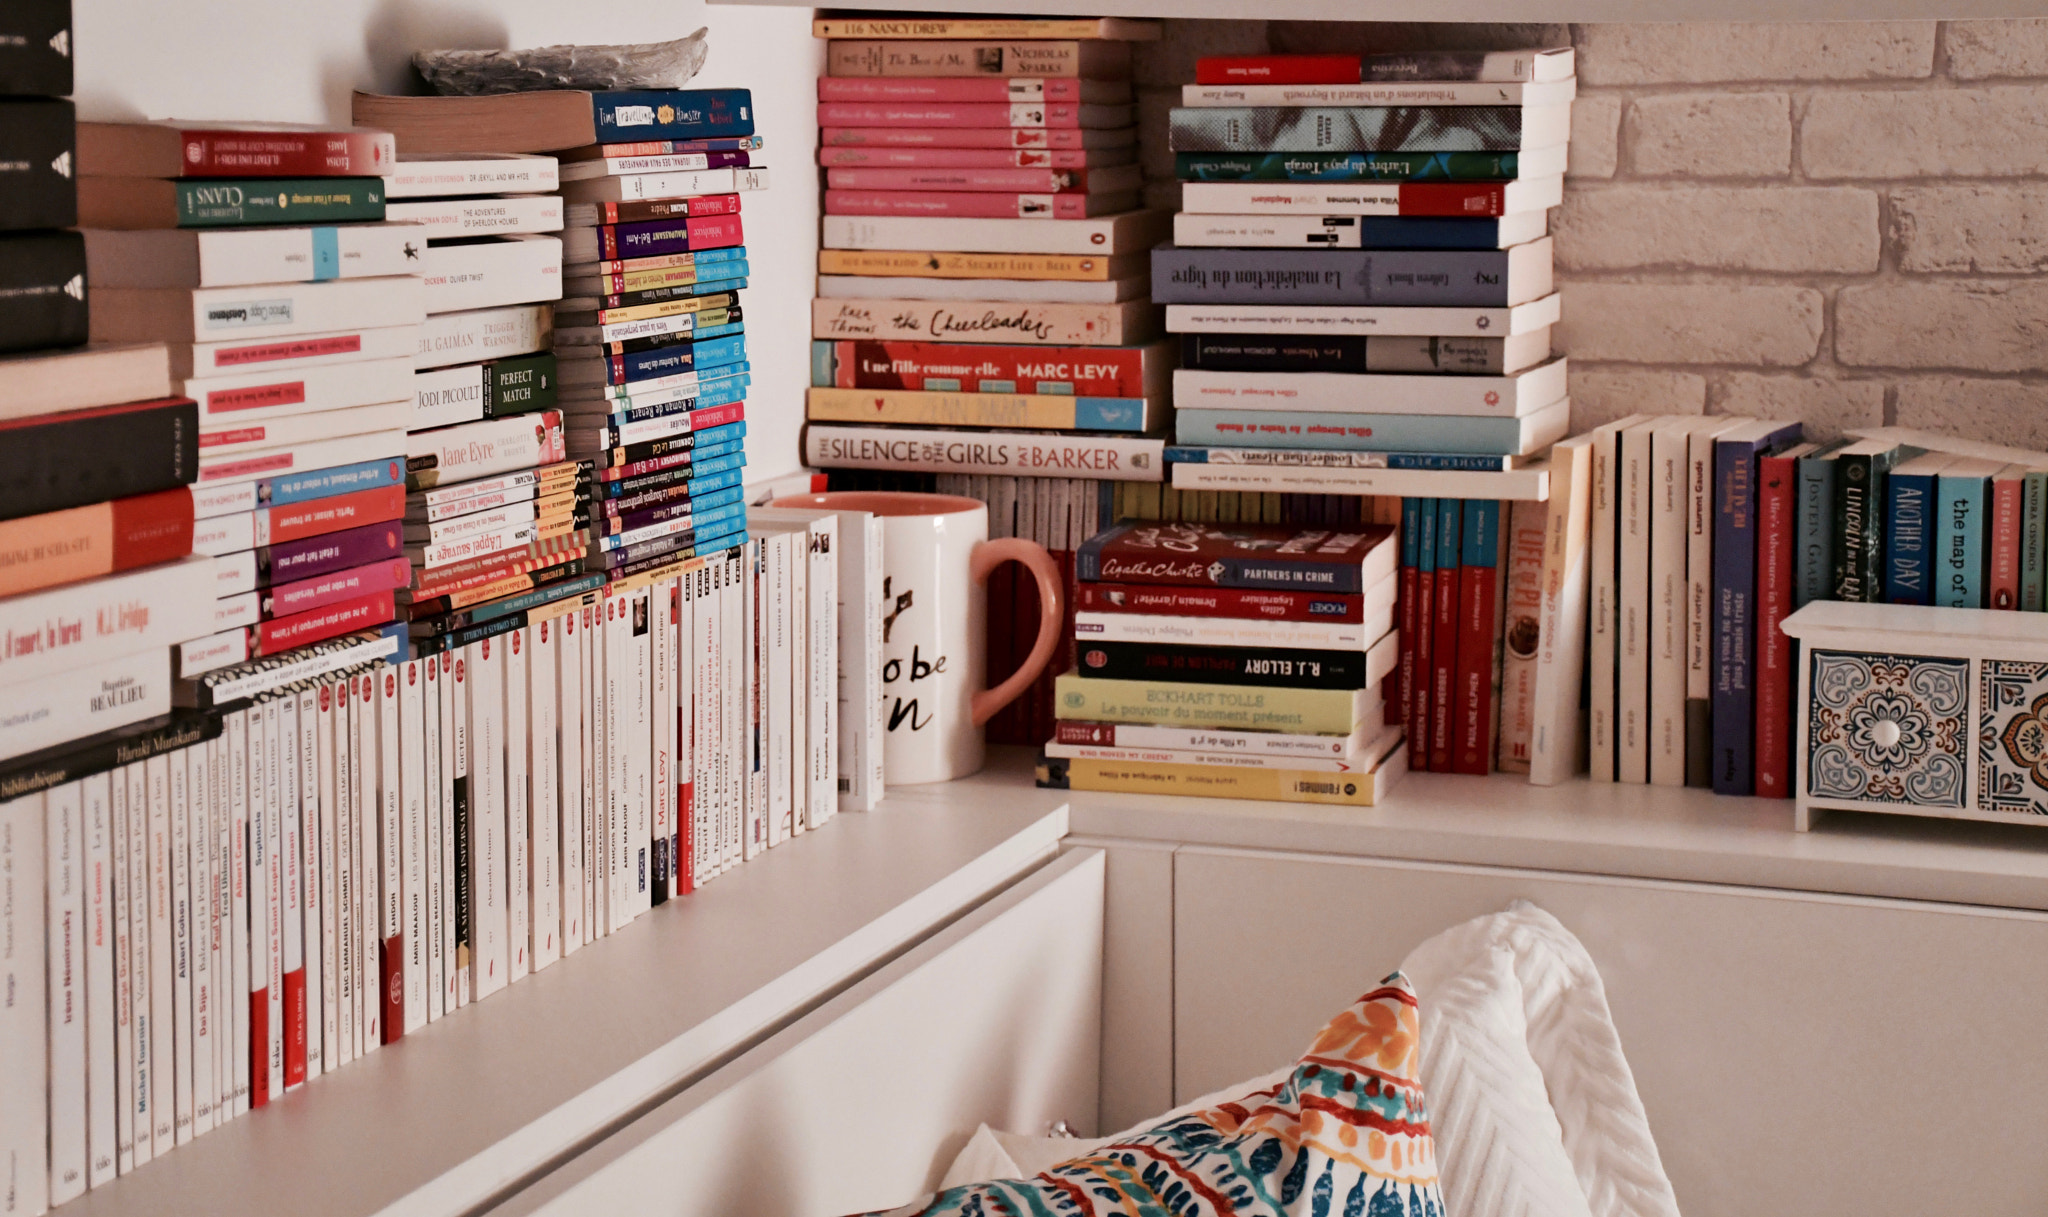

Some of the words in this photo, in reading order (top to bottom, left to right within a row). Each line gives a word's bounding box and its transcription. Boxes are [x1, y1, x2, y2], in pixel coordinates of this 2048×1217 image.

[869, 22, 909, 35] NANCY
[912, 22, 949, 35] DREW
[1010, 46, 1070, 59] NICHOLAS
[1017, 62, 1062, 73] SPARKS
[1283, 88, 1329, 102] Beyrouth
[1339, 89, 1371, 102] bâtard
[1373, 89, 1393, 102] d'un
[1395, 89, 1457, 102] Tribulations
[599, 107, 616, 126] Time
[617, 108, 653, 126] Travelling
[676, 106, 702, 123] Hamster
[326, 139, 349, 155] JAMES
[326, 156, 350, 171] ELOISA
[672, 157, 690, 169] JOURNAL
[1284, 159, 1323, 175] Toraja
[1323, 158, 1349, 173] pays
[1351, 161, 1368, 174] du
[1368, 161, 1411, 175] L'arbre
[516, 171, 530, 181] HYDE
[196, 186, 244, 207] CLANS
[463, 208, 473, 217] THE
[474, 207, 506, 217] ADVENTURES
[463, 219, 472, 228] OF
[472, 217, 498, 228] SHERLOCK
[499, 216, 519, 227] HOLMES
[626, 232, 651, 246] Bel-Ami
[652, 229, 688, 241] MAUPASSANT
[967, 259, 1006, 271] SECRET
[1009, 260, 1034, 271] LIFE
[424, 276, 447, 286] DICKENS
[449, 274, 468, 285] OLIVER
[468, 273, 484, 283] TWIST
[1170, 264, 1209, 290] tigre
[1212, 270, 1231, 290] du
[1234, 270, 1320, 291] malédiction
[1323, 270, 1342, 290] La
[207, 308, 247, 322] Constance
[484, 322, 515, 334] TRIGGER
[892, 312, 920, 331] the
[930, 309, 1055, 340] Cheerleaders
[435, 332, 474, 352] GAIMAN
[482, 334, 517, 349] WARNING
[892, 358, 920, 375] fille
[923, 361, 973, 375] comme
[974, 360, 1001, 376] elle
[1016, 361, 1068, 379] MARC
[1073, 363, 1119, 381] LEVY
[500, 369, 533, 386] PERFECT
[417, 390, 440, 410] JODI
[442, 384, 480, 405] PICOULT
[502, 387, 532, 403] MATCH
[687, 397, 696, 409] Le
[631, 405, 655, 420] Renart
[655, 404, 664, 416] de
[664, 399, 687, 413] Roman
[668, 436, 694, 451] CORNEILLE
[831, 438, 919, 462] SILENCE
[947, 443, 1009, 466] GIRLS
[440, 445, 468, 469] Jane
[468, 441, 495, 462] Eyre
[1017, 445, 1029, 467] PAT
[1032, 448, 1119, 471] BARKER
[1279, 450, 1309, 464] than
[1311, 450, 1353, 464] Louder
[632, 460, 647, 476] Bal
[650, 458, 660, 472] Le
[359, 469, 379, 483] Arthur
[513, 474, 533, 487] VOLTAIRE
[1693, 460, 1704, 493] Gaudé
[1805, 475, 1823, 537] JOSTEIN
[2029, 478, 2039, 522] SANDRA
[279, 514, 304, 529] trouver
[1694, 496, 1703, 535] Laurent
[1768, 496, 1781, 529] Alice's
[1845, 487, 1863, 549] LINCOLN
[1894, 486, 1924, 553] ANOTHER
[1952, 498, 1969, 530] the
[2000, 489, 2013, 543] VERONICA
[470, 532, 503, 553] L'Appel
[514, 528, 530, 541] LONDON
[318, 548, 333, 562] était
[436, 542, 471, 562] sauvage
[1516, 528, 1544, 568] LIFE
[1949, 535, 1967, 570] map
[2027, 523, 2038, 572] CISNEROS
[290, 551, 306, 565] pour
[306, 551, 318, 563] fait
[1766, 531, 1780, 589] Adventures
[1998, 548, 2011, 580] HENRY
[1102, 558, 1152, 578] Agatha
[1150, 560, 1204, 578] Christie
[1243, 568, 1291, 582] PARTNERS
[1293, 569, 1303, 582] IN
[1305, 570, 1334, 584] CRIME
[1893, 557, 1922, 591] DAY
[316, 582, 331, 597] pour
[331, 580, 345, 593] robe
[346, 577, 359, 590] Une
[1952, 573, 1969, 600] of
[283, 586, 315, 604] Versailles
[1179, 596, 1217, 608] Demain
[1240, 595, 1294, 606] Legardinier
[1514, 589, 1541, 607] PI
[1718, 588, 1731, 617] serez
[338, 610, 351, 622] sais
[359, 605, 368, 617] Je
[1260, 605, 1286, 615] Gilles
[1308, 601, 1347, 615] POCKET
[1733, 592, 1745, 624] triste
[298, 614, 325, 632] pourquoi
[325, 610, 339, 625] plus
[270, 627, 291, 641] t'aime
[1765, 605, 1778, 669] Wonderland
[1718, 636, 1731, 661] vous
[1733, 626, 1746, 664] jamais
[1245, 658, 1292, 675] ELLORY
[1692, 645, 1702, 670] Pour
[100, 675, 135, 693] Baptiste
[1437, 667, 1448, 705] WERBER
[1733, 665, 1745, 689] plus
[90, 685, 146, 713] BEAULIEU
[1146, 688, 1213, 705] ECKHART
[1218, 690, 1266, 708] TOLLE
[1468, 672, 1479, 709] ALPHEN
[1101, 701, 1117, 715] Le
[1121, 702, 1170, 720] pouvoir
[1173, 704, 1191, 719] du
[1194, 708, 1250, 721] moment
[1252, 708, 1304, 727] présent
[1435, 705, 1447, 748] BERNARD
[116, 735, 151, 764] Haruki
[152, 726, 200, 757] Murakami
[458, 726, 466, 771] COCTEAU
[657, 749, 668, 785] Levy
[1, 767, 67, 800] bibliothèque
[1299, 782, 1341, 796] Femmes
[657, 786, 665, 826] Marc
[254, 811, 264, 867] Sophocle
[457, 799, 469, 868] INFERNALE
[92, 861, 103, 905] Camus
[458, 870, 469, 926] MACHINE
[93, 907, 104, 947] Albert
[177, 900, 188, 938] Cohen
[61, 909, 74, 988] Némirovsky
[178, 940, 188, 980] Albert
[62, 990, 72, 1025] Irène
[136, 1015, 147, 1068] Tournier
[137, 1070, 147, 1114] Michel
